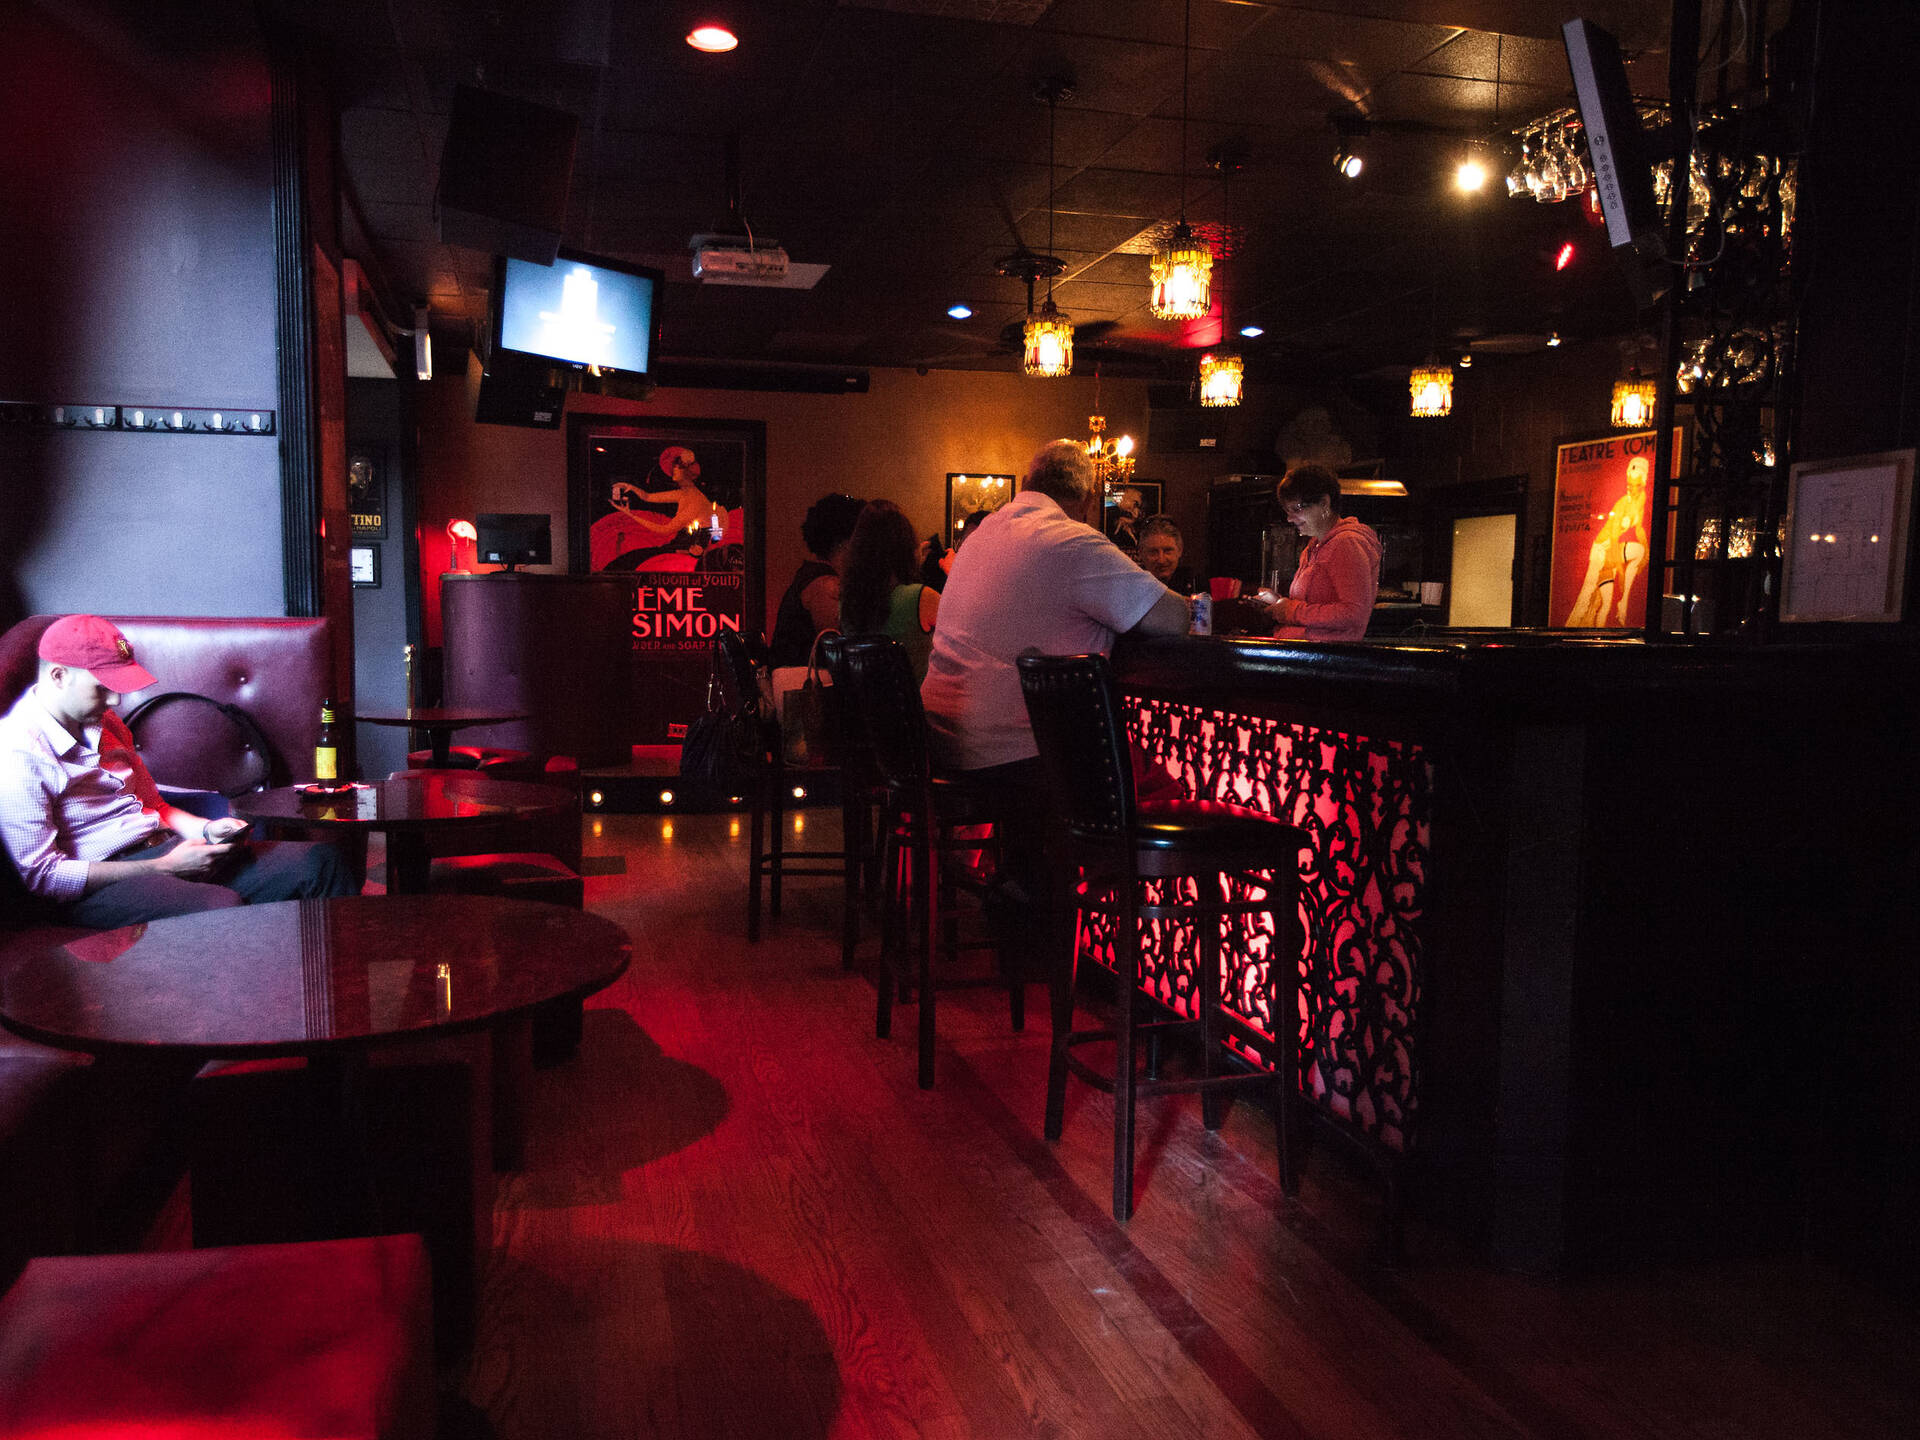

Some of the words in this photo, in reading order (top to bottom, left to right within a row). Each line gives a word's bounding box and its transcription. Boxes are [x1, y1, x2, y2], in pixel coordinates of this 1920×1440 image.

[1560, 441, 1615, 465] TEATRE
[1624, 436, 1656, 455] COM
[351, 514, 381, 526] TINO
[632, 612, 740, 638] SIMON
